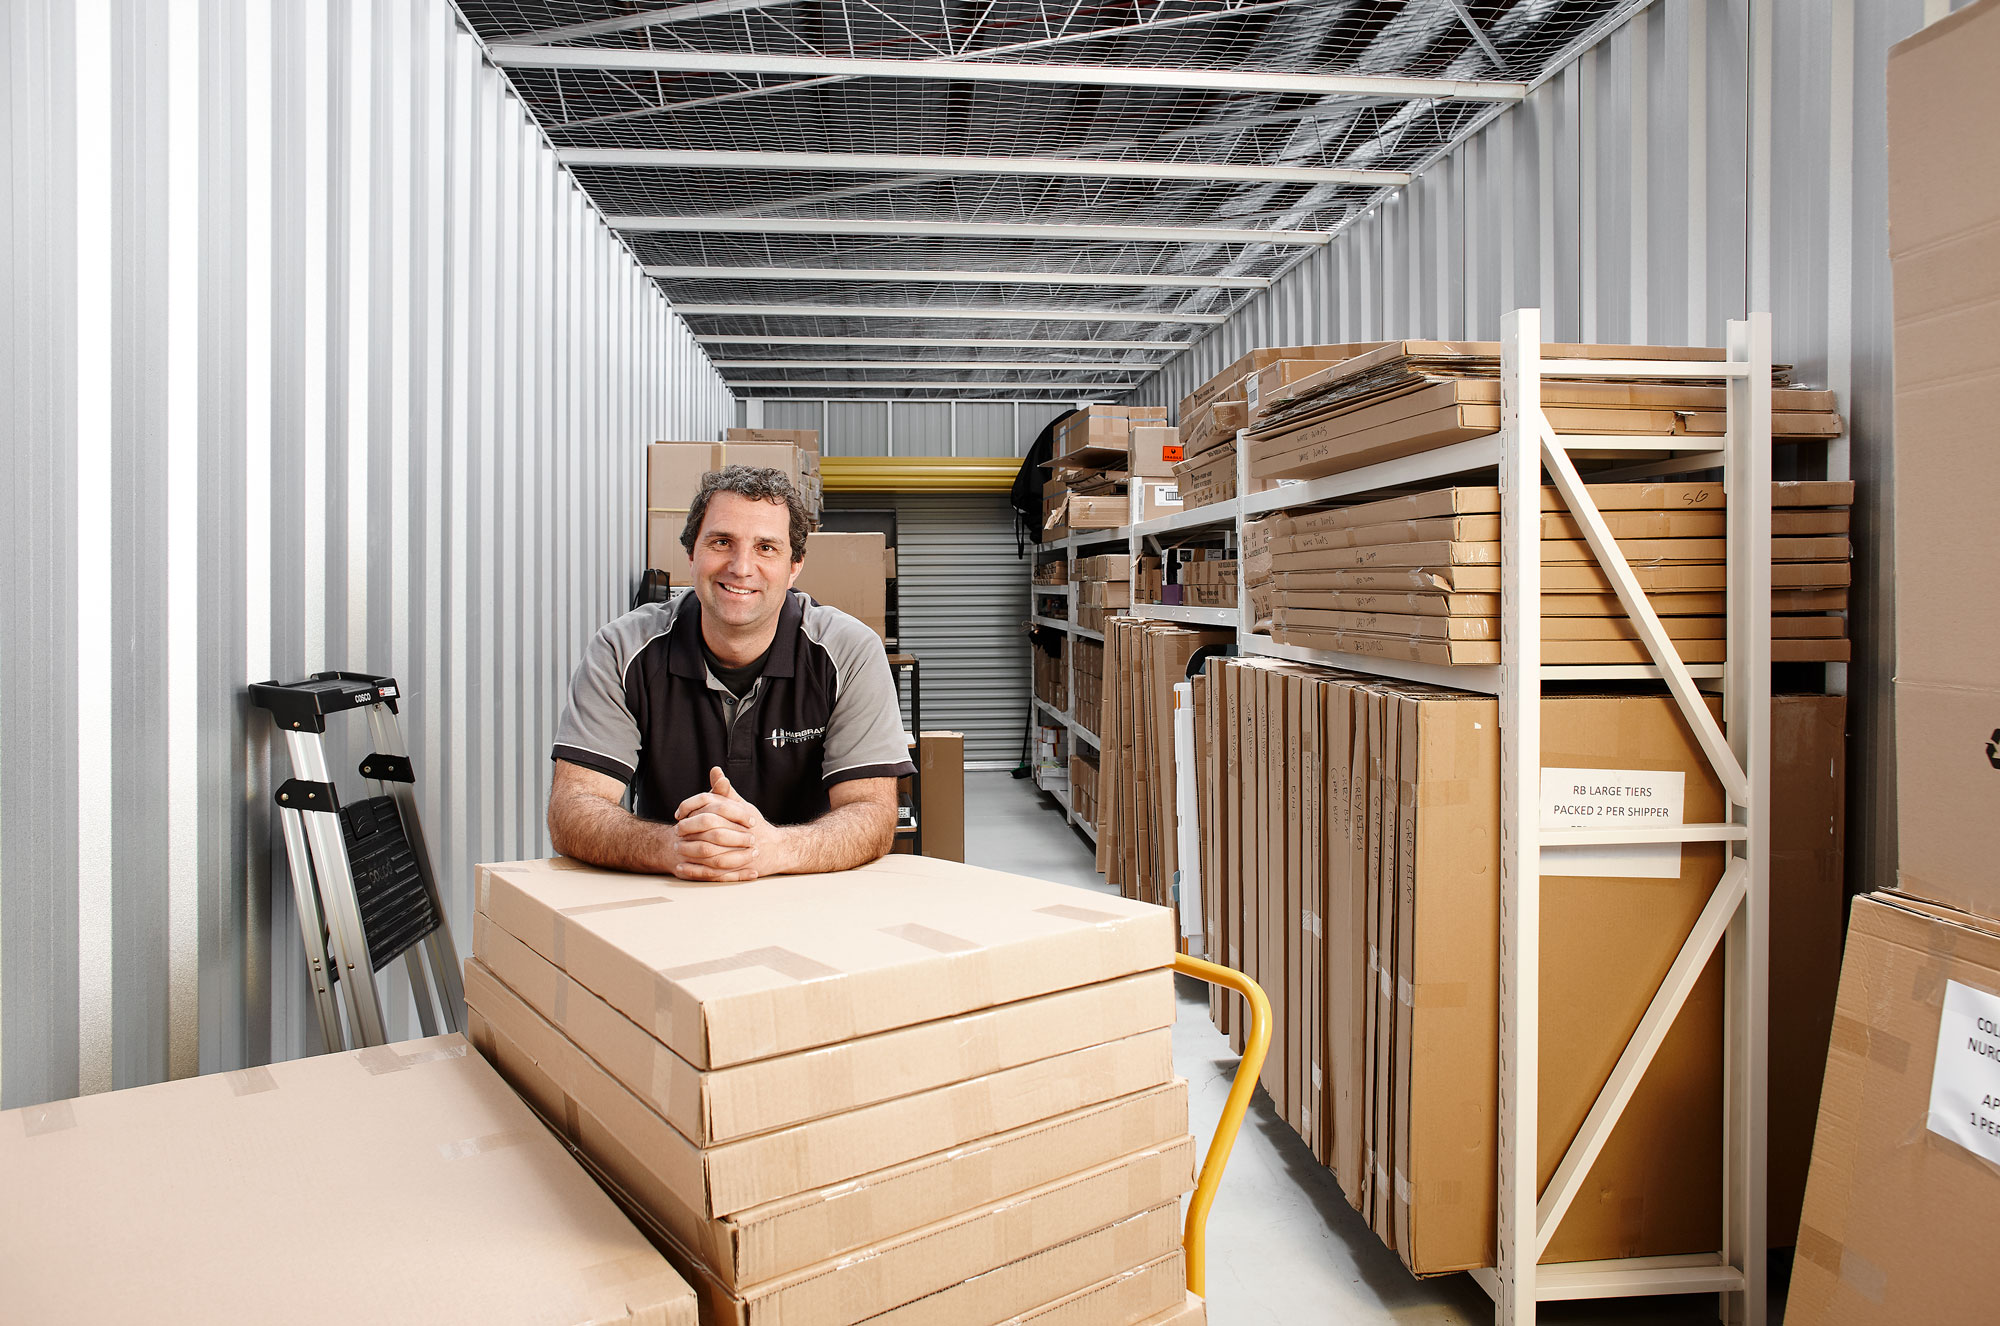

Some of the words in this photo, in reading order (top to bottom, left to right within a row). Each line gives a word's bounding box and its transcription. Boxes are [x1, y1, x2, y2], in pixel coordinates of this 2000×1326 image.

[354, 692, 371, 703] COSCO
[1354, 776, 1363, 811] GREY
[1573, 785, 1587, 795] RB
[1589, 786, 1622, 796] LARGE
[1625, 787, 1652, 797] TIERS
[1373, 795, 1381, 841] GREY
[1553, 804, 1594, 816] PACKED
[1597, 806, 1603, 816] 2
[1606, 806, 1625, 816] PER
[1628, 806, 1669, 817] SHIPPER
[1356, 814, 1364, 851] BINS
[1405, 818, 1414, 858] GREY
[1405, 863, 1413, 904] BINS
[1970, 1112, 1977, 1127] 1
